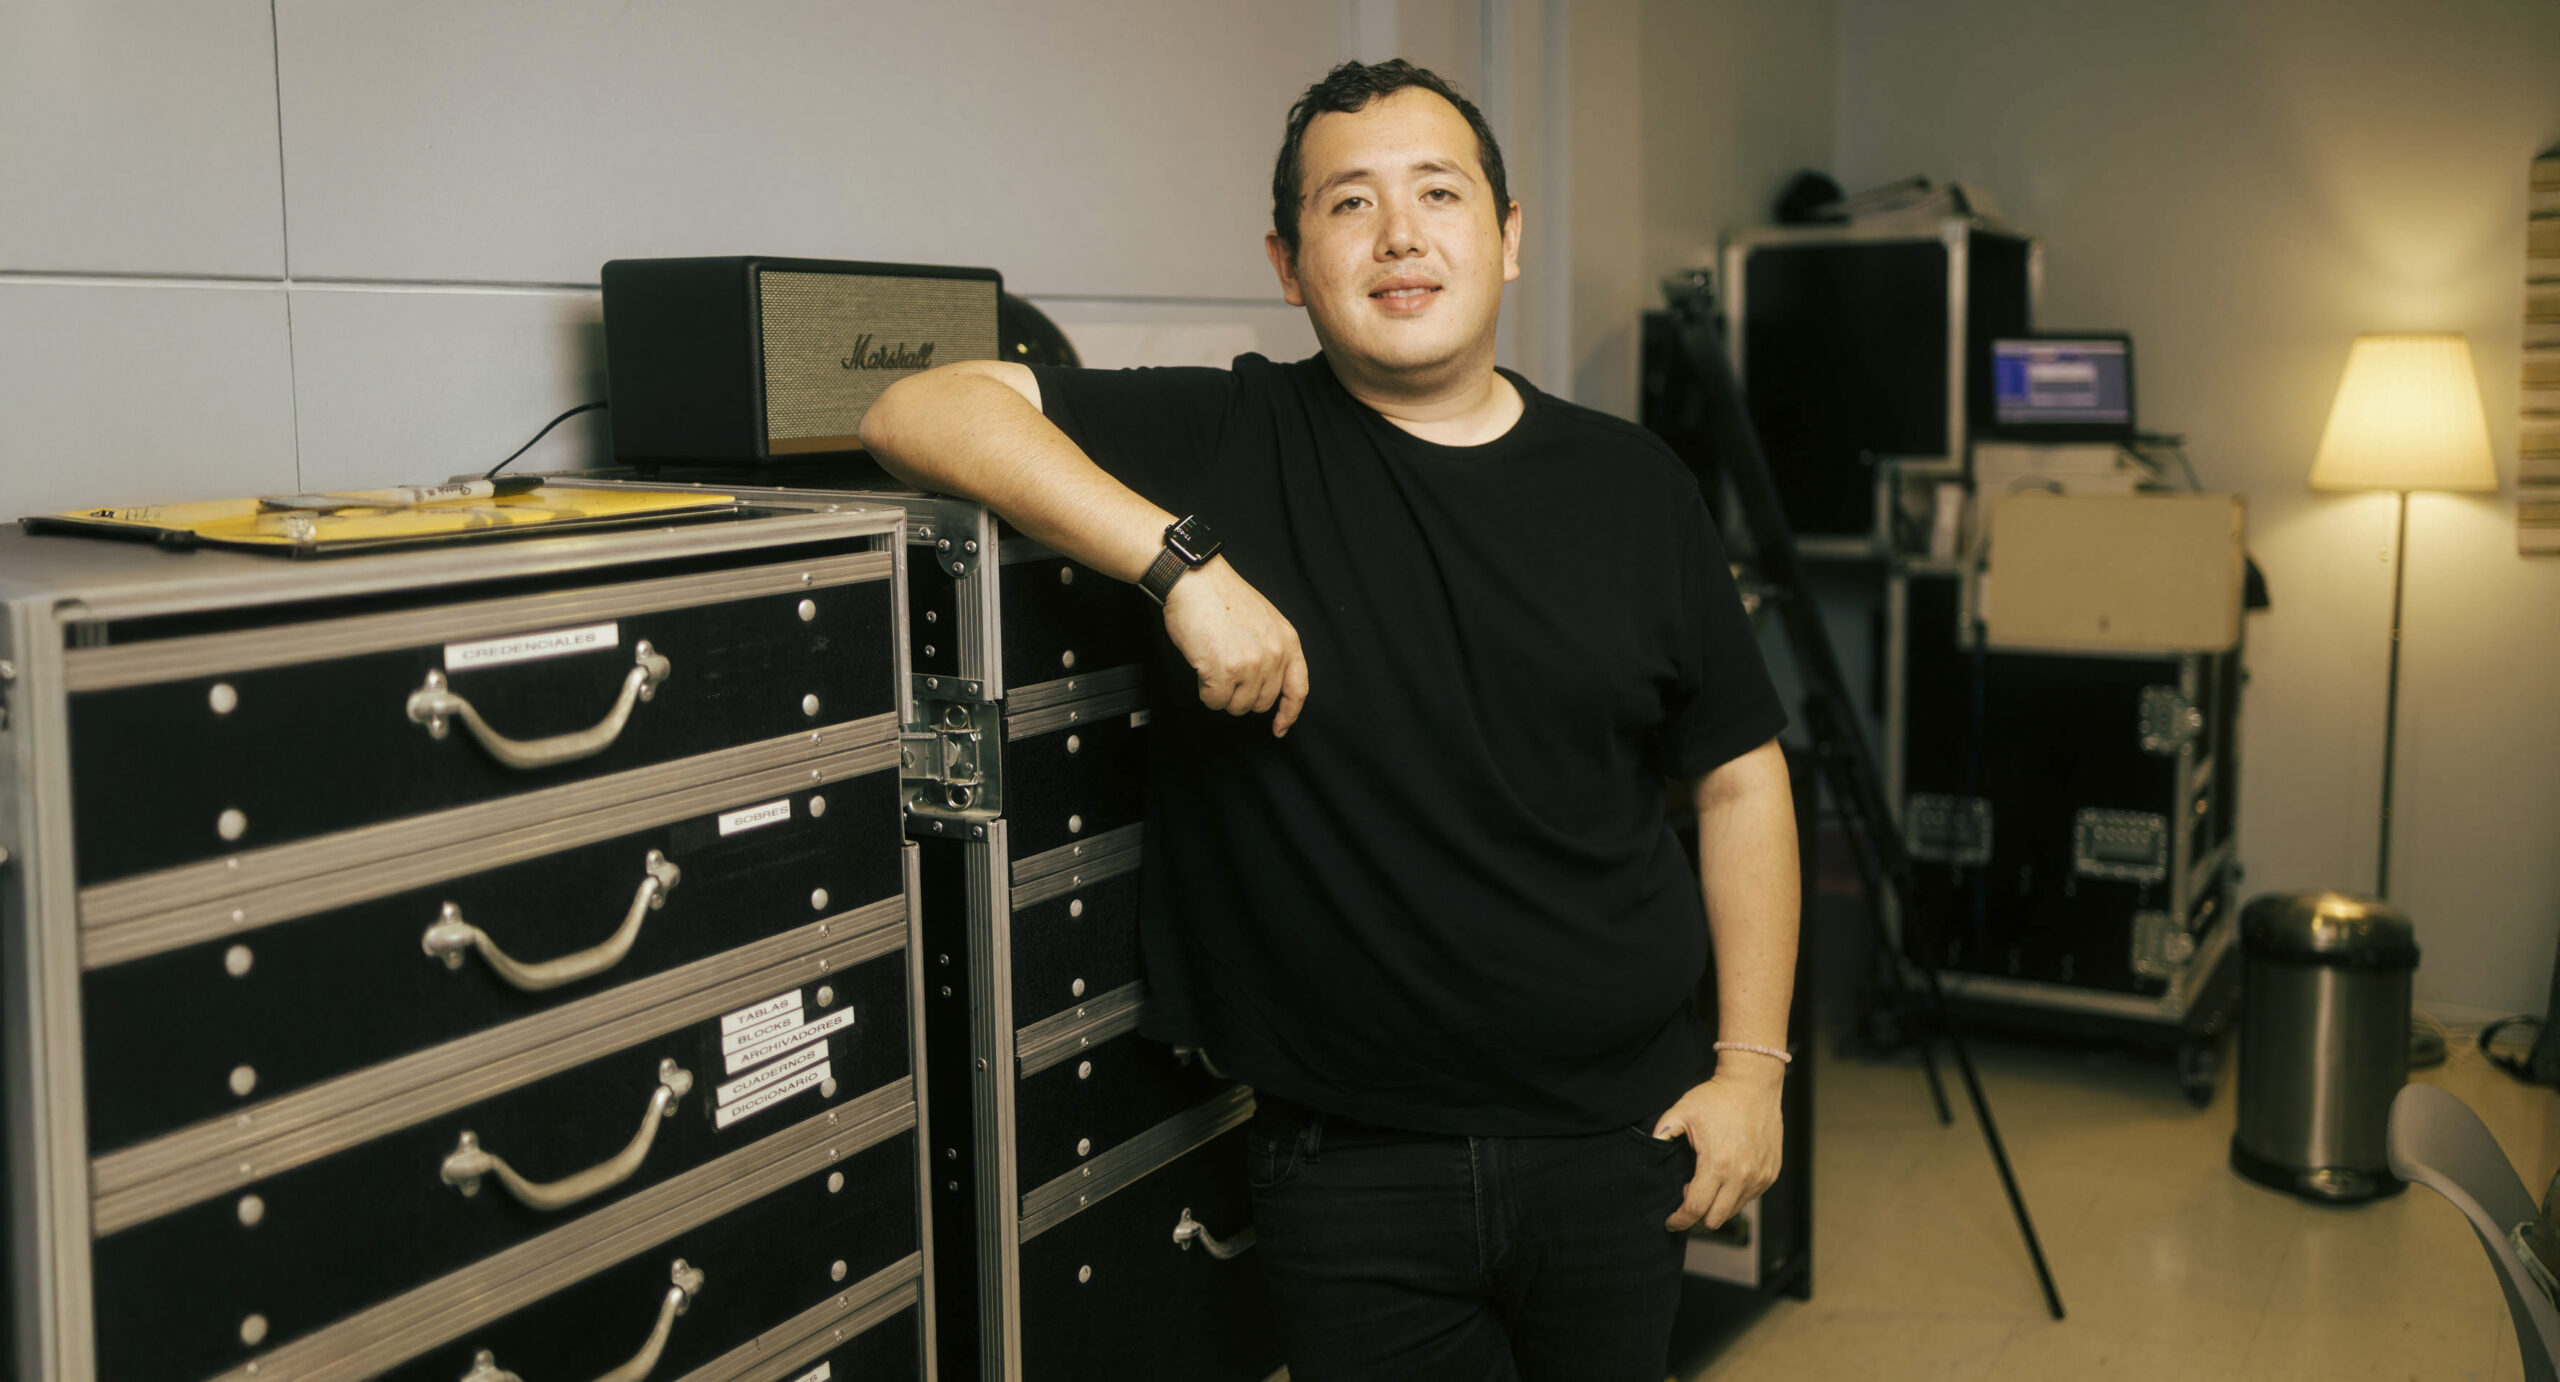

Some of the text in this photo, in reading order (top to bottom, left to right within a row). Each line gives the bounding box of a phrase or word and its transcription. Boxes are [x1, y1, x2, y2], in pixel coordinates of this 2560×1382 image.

[841, 333, 935, 371] Marshall
[462, 633, 596, 660] CREDENCIALES
[734, 806, 789, 826] SOBRES
[737, 999, 789, 1024] TABLAS
[737, 1018, 792, 1045] BLOCKS
[741, 1016, 843, 1063] ARCHIVADORES
[732, 1050, 816, 1094] CUADERNOS
[731, 1072, 818, 1117] DICCIONARIO
